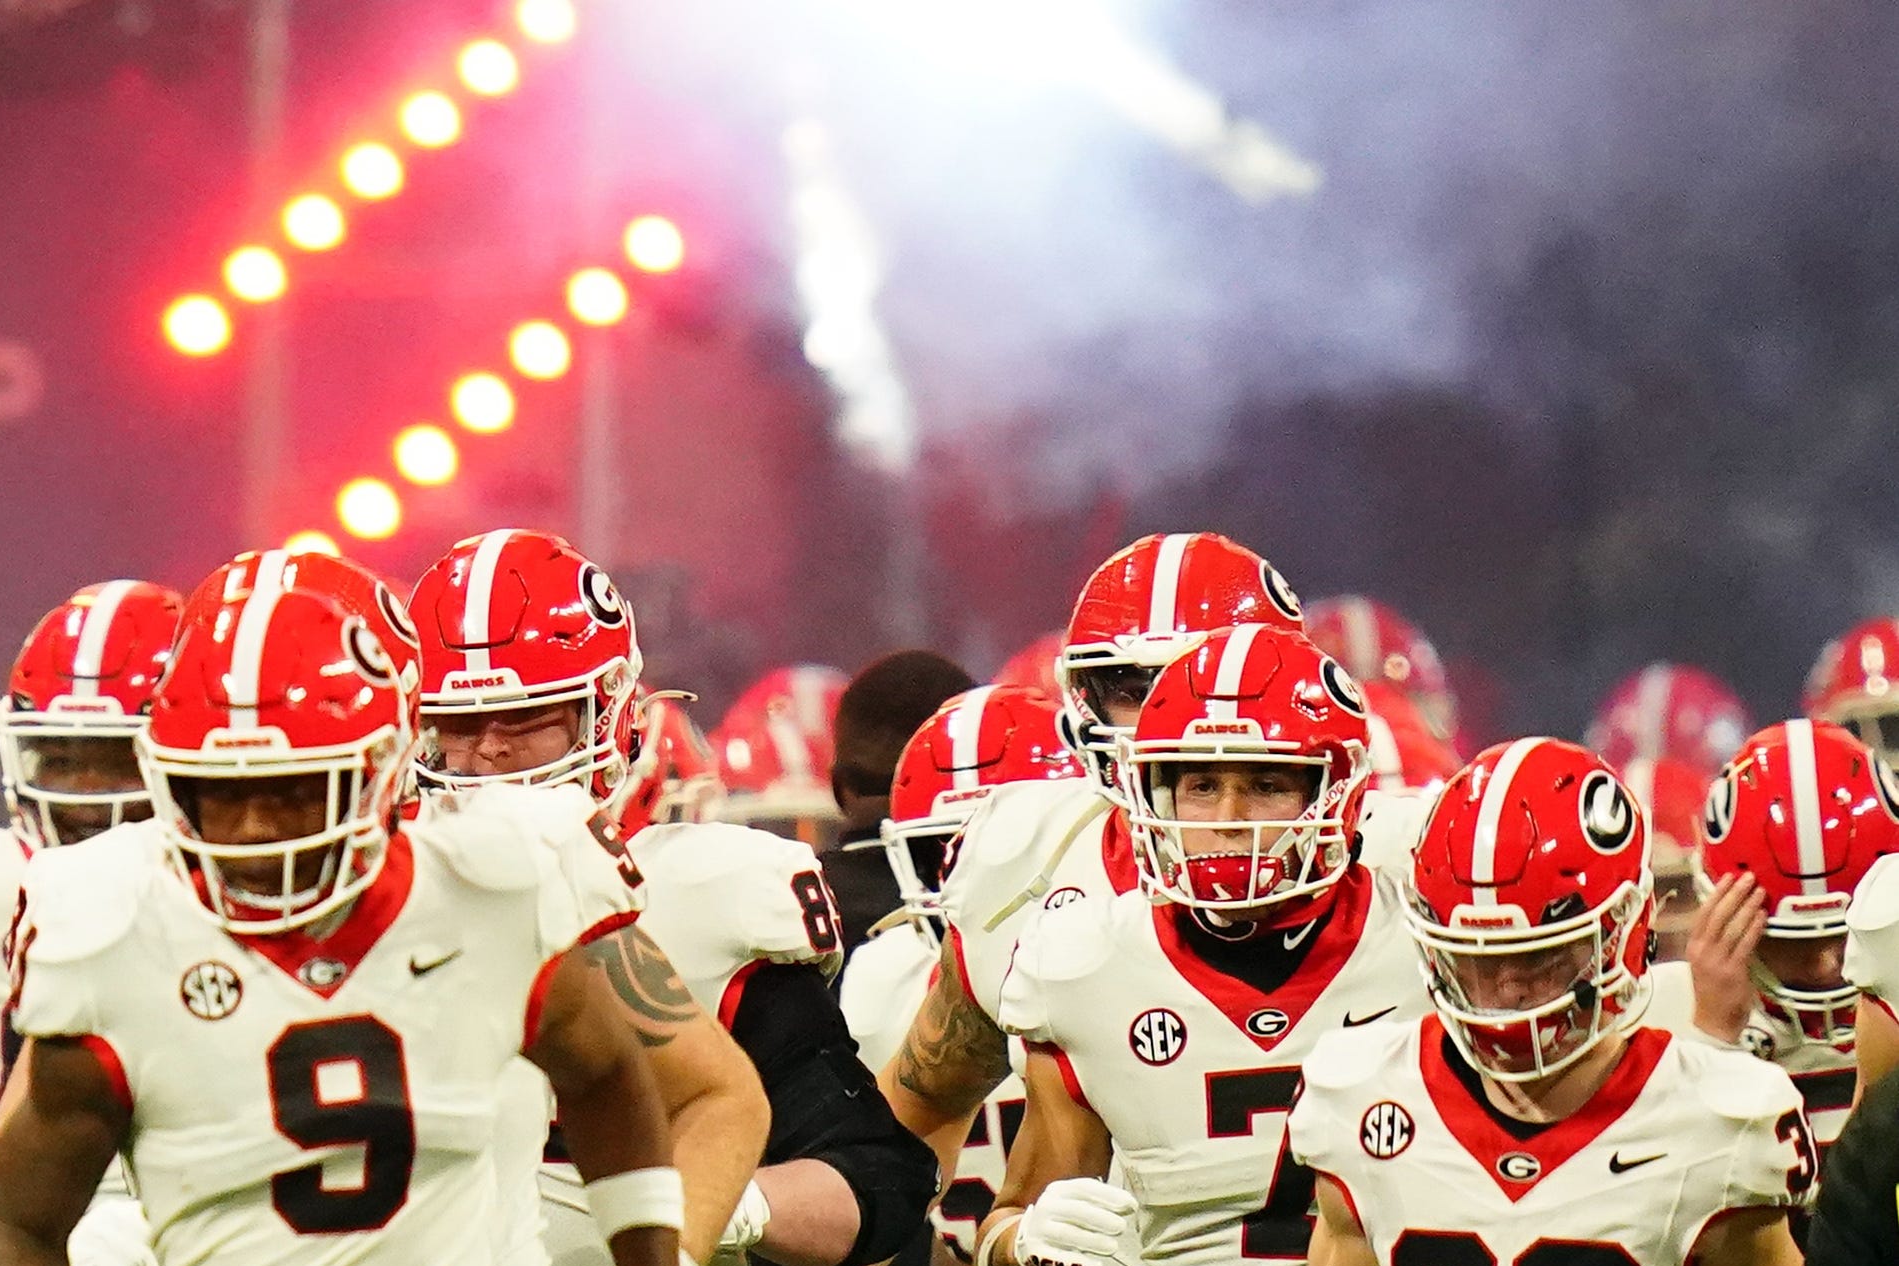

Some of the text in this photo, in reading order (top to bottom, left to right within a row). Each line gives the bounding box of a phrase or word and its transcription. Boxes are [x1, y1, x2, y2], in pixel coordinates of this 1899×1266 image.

[451, 676, 505, 690] DAWGS
[1132, 1011, 1186, 1063] SEC
[266, 1011, 416, 1236] 9
[1361, 1103, 1414, 1158] SEC
[1774, 1107, 1822, 1194] 3
